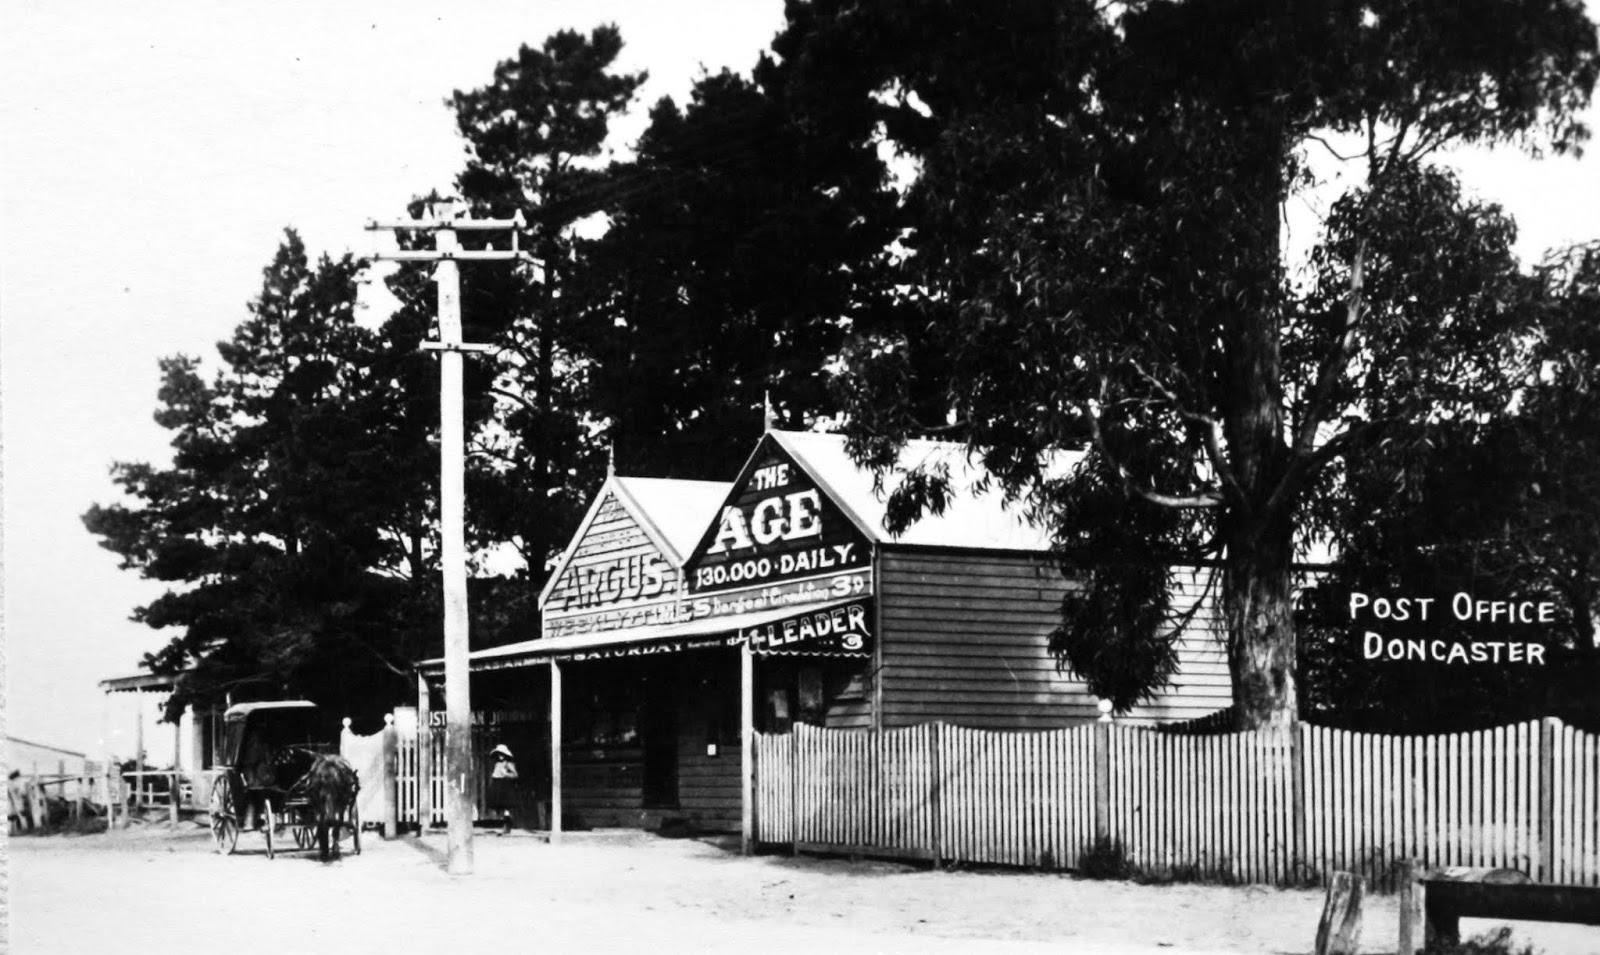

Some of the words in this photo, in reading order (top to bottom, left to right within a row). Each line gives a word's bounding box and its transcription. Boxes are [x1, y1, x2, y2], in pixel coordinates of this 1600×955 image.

[754, 463, 789, 490] THE
[707, 488, 822, 554] AGE
[768, 604, 871, 646] LEADER
[574, 643, 682, 661] SATURDAY
